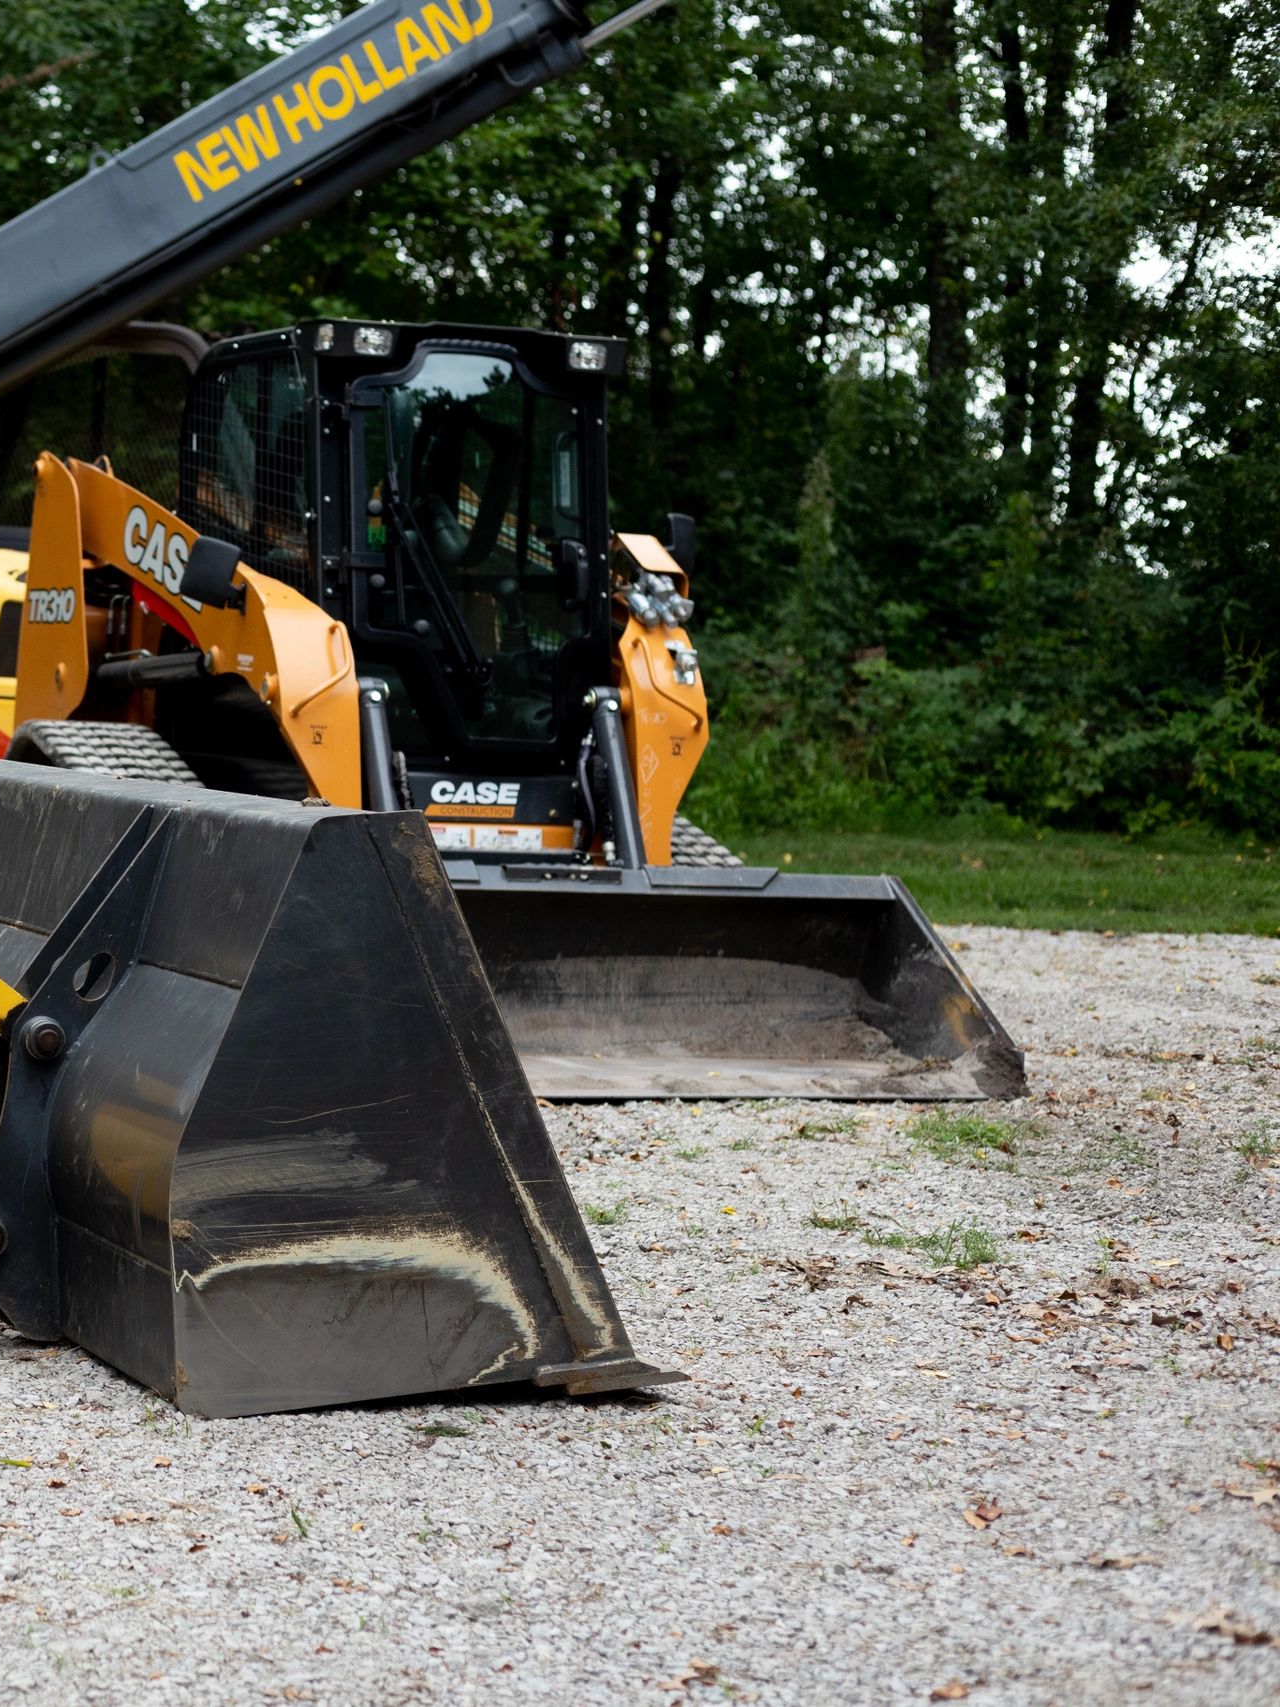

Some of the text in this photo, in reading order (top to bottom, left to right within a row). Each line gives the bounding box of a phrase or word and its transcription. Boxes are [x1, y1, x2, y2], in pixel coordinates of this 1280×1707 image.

[173, 0, 494, 203] NEW HOLLAND
[123, 504, 204, 614] CAS
[28, 587, 76, 624] TR310
[430, 780, 521, 805] CASE
[439, 805, 513, 817] CONSTRUCTION
